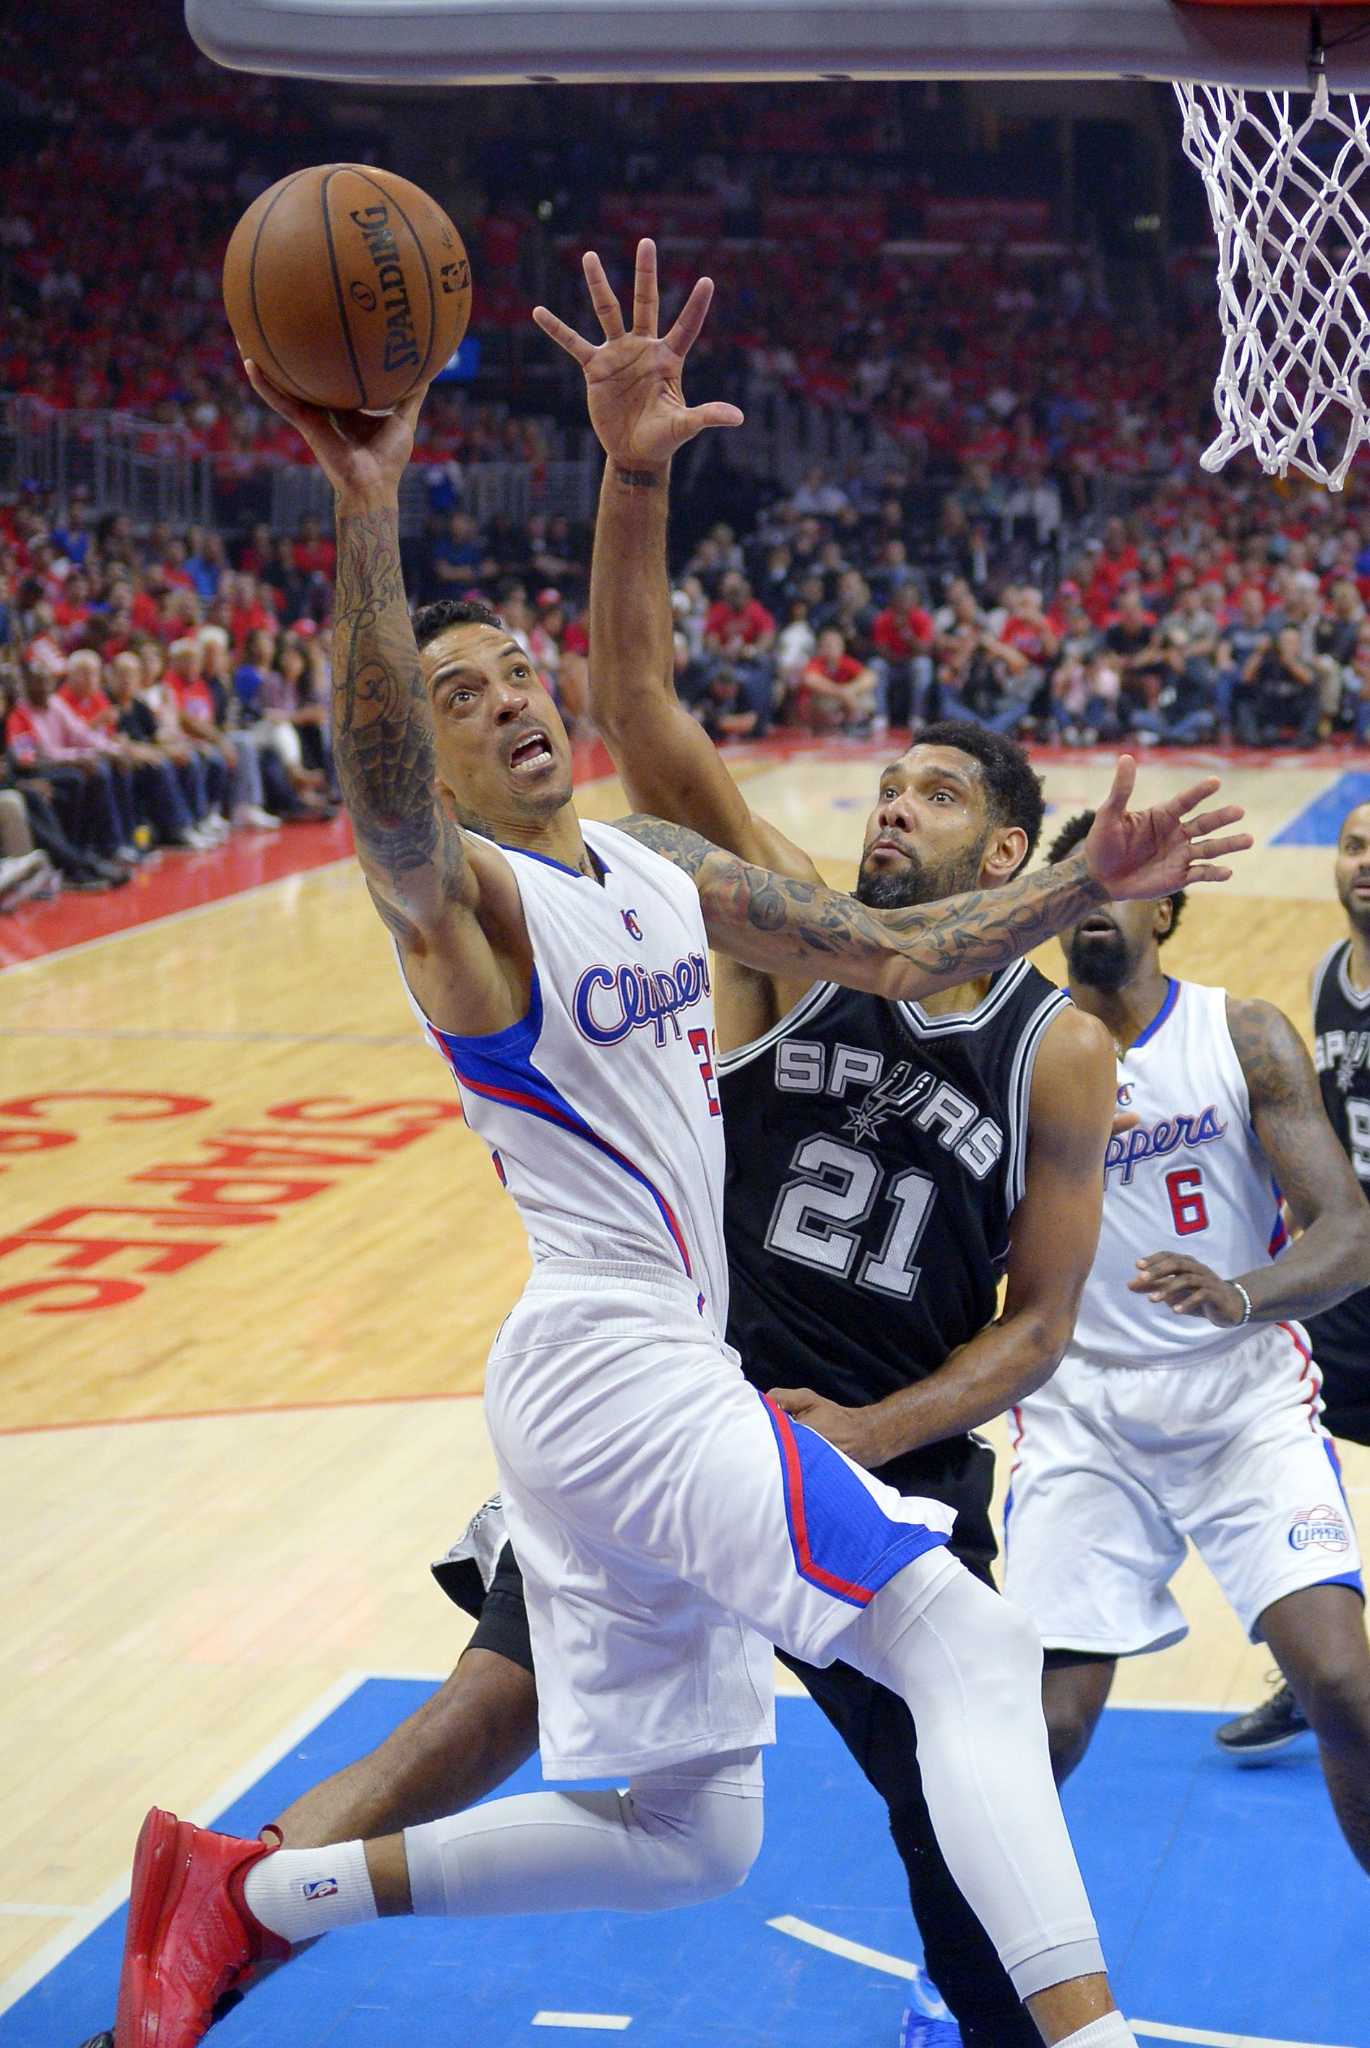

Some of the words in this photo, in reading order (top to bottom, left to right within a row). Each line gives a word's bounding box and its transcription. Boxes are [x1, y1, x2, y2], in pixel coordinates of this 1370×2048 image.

[350, 204, 420, 373] SPALDING
[573, 952, 711, 1047] Clipper
[687, 1027, 721, 1116] 2
[775, 1037, 1004, 1180] SPURS
[1103, 1104, 1229, 1191] ppers
[763, 1131, 940, 1302] 21
[1164, 1167, 1210, 1236] 6
